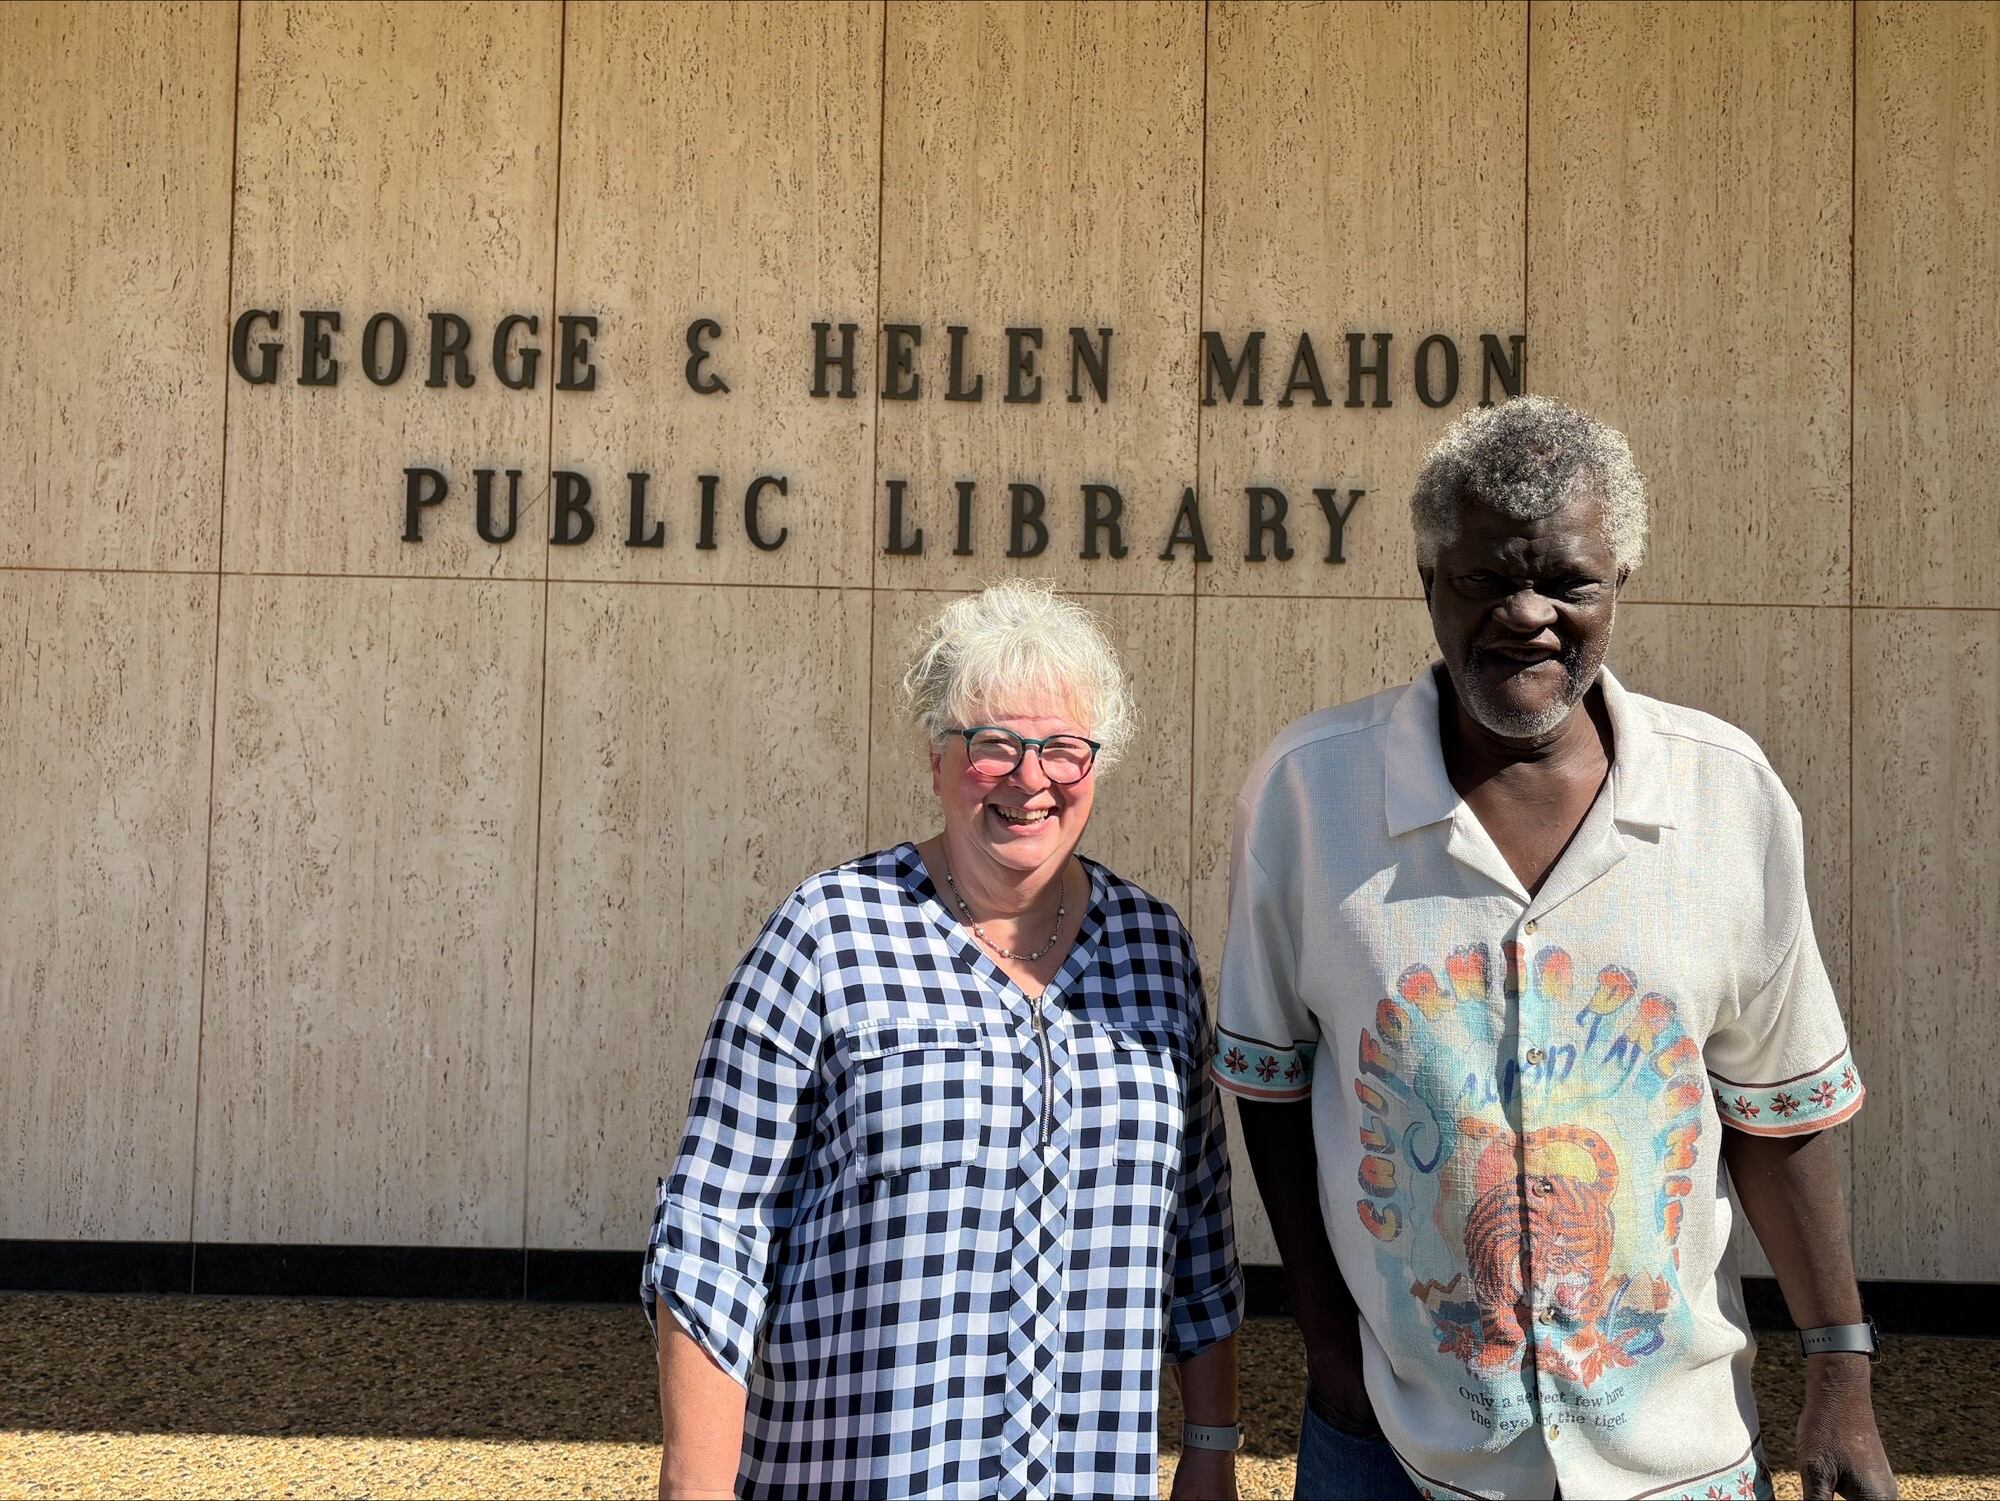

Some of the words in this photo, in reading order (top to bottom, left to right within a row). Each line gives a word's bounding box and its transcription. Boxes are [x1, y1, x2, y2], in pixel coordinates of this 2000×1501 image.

[231, 308, 600, 392] GEORGE
[685, 318, 731, 395] &
[810, 322, 1114, 405] HELEN
[1201, 330, 1526, 409] MAHON
[400, 466, 790, 552] PUBLIC
[883, 479, 1367, 565] LIBRARY
[1458, 1386, 1494, 1411] Only
[1501, 1397, 1513, 1408] a
[1575, 1395, 1603, 1408] few
[1604, 1386, 1624, 1405] have
[1470, 1407, 1492, 1429] the
[1499, 1418, 1529, 1434] eye
[1558, 1411, 1586, 1424] the
